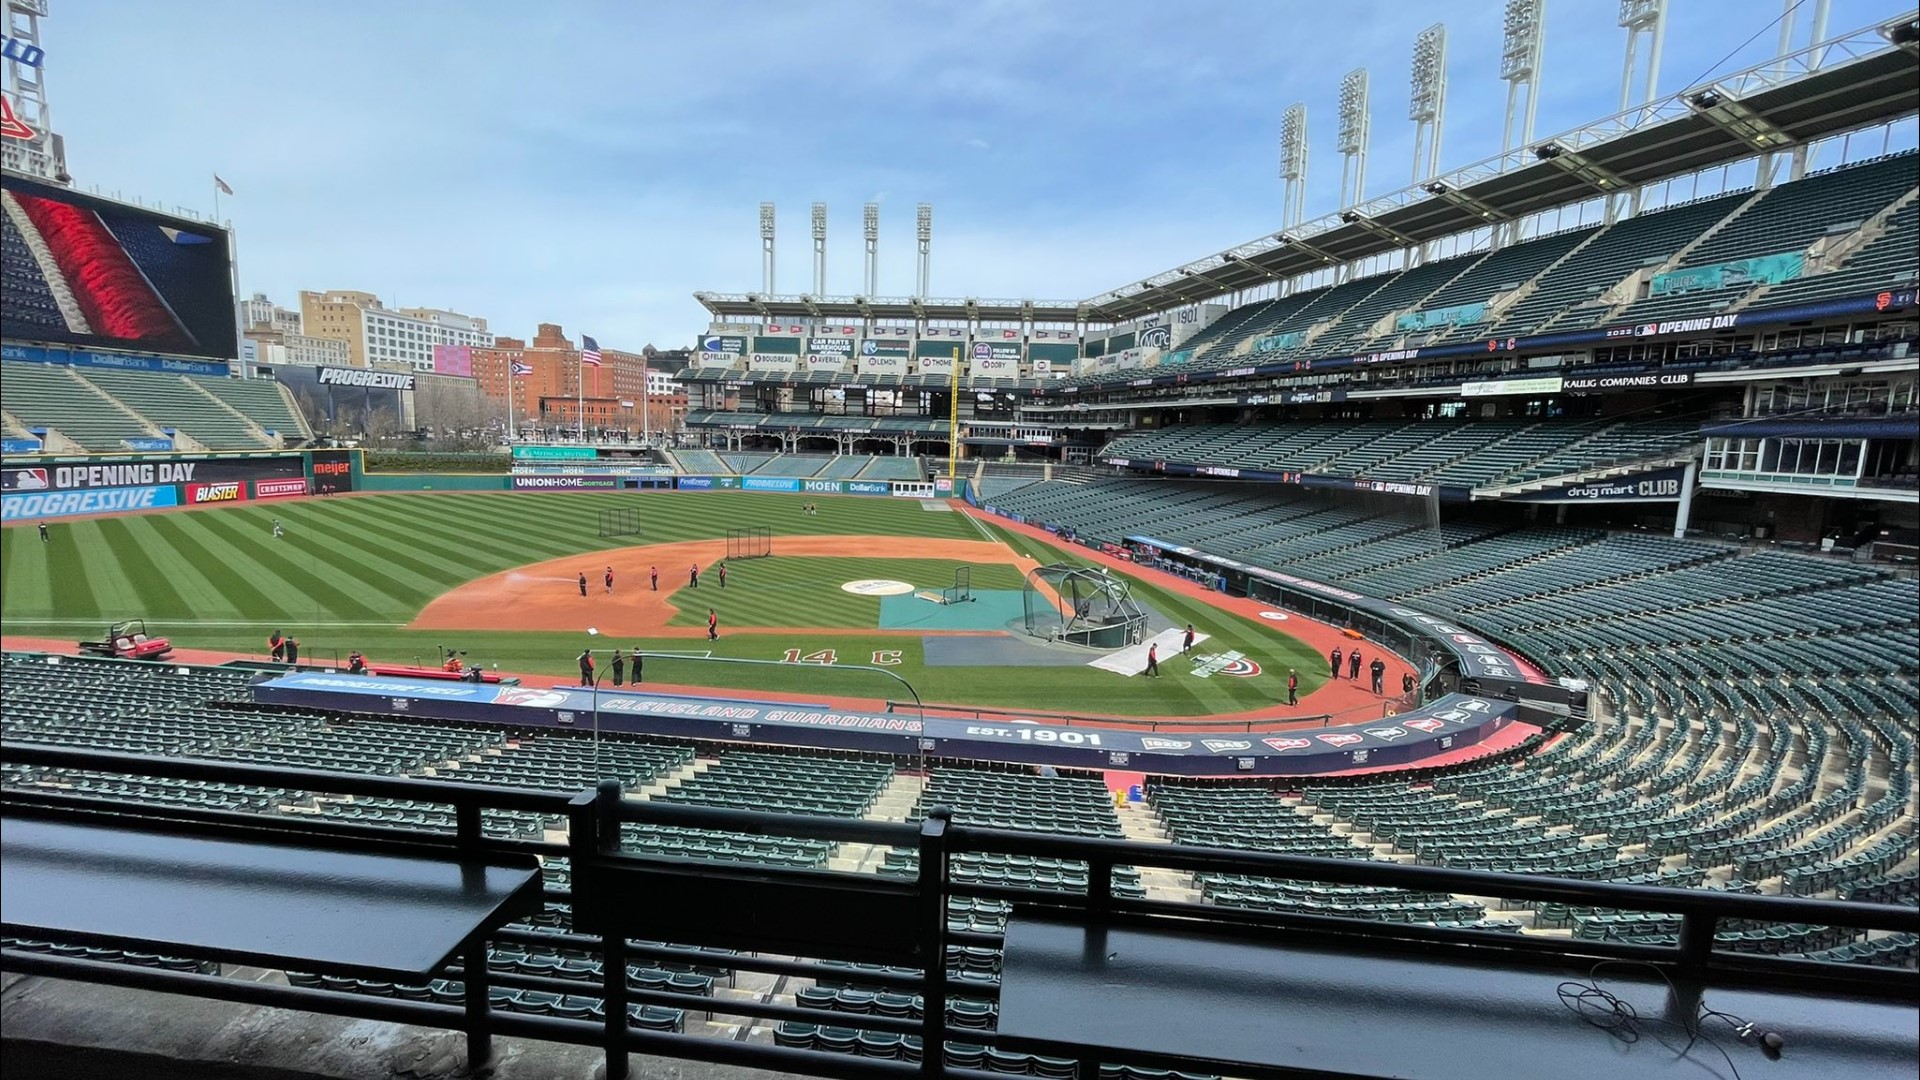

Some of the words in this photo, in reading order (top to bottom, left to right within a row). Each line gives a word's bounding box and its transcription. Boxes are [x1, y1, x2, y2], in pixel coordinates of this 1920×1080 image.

[1177, 307, 1198, 324] 1901
[1658, 320, 1711, 334] OPENING
[1711, 314, 1738, 329] DAY
[810, 344, 851, 352] WAREHOUSE
[91, 353, 150, 369] DollarBank
[710, 353, 731, 361] FELLER
[762, 355, 793, 363] BOUDREAU
[818, 356, 842, 364] AVERILL
[1380, 351, 1406, 362] OPENING
[1405, 349, 1419, 360] DAY
[162, 359, 213, 373] DollarBank
[932, 359, 952, 367] THOME
[319, 368, 415, 390] PROGRESSIVE
[1563, 379, 1597, 389] KAULIG
[1599, 376, 1657, 387] COMPANIES
[1660, 374, 1689, 384] CLUB
[55, 465, 155, 488] OPENING
[158, 463, 195, 483] DAY
[313, 462, 350, 476] meijer
[260, 484, 302, 493] CRAFTSMAN
[516, 478, 583, 487] UNIONHOME
[745, 479, 794, 489] PROGRESSIVE
[805, 481, 840, 492] MOEN
[850, 483, 886, 493] DollarBank
[1384, 482, 1416, 495] OPENING
[1415, 486, 1432, 497] DAY
[1568, 487, 1599, 499] drug
[1600, 485, 1635, 495] mart
[1638, 479, 1678, 496] CLUB
[196, 486, 239, 502] BLASTER
[779, 648, 838, 665] 14
[871, 650, 902, 666] C
[601, 699, 759, 719] CLEVELAND
[764, 710, 925, 732] GUARDIANS
[966, 726, 1013, 737] EST.
[1016, 728, 1102, 745] 1901
